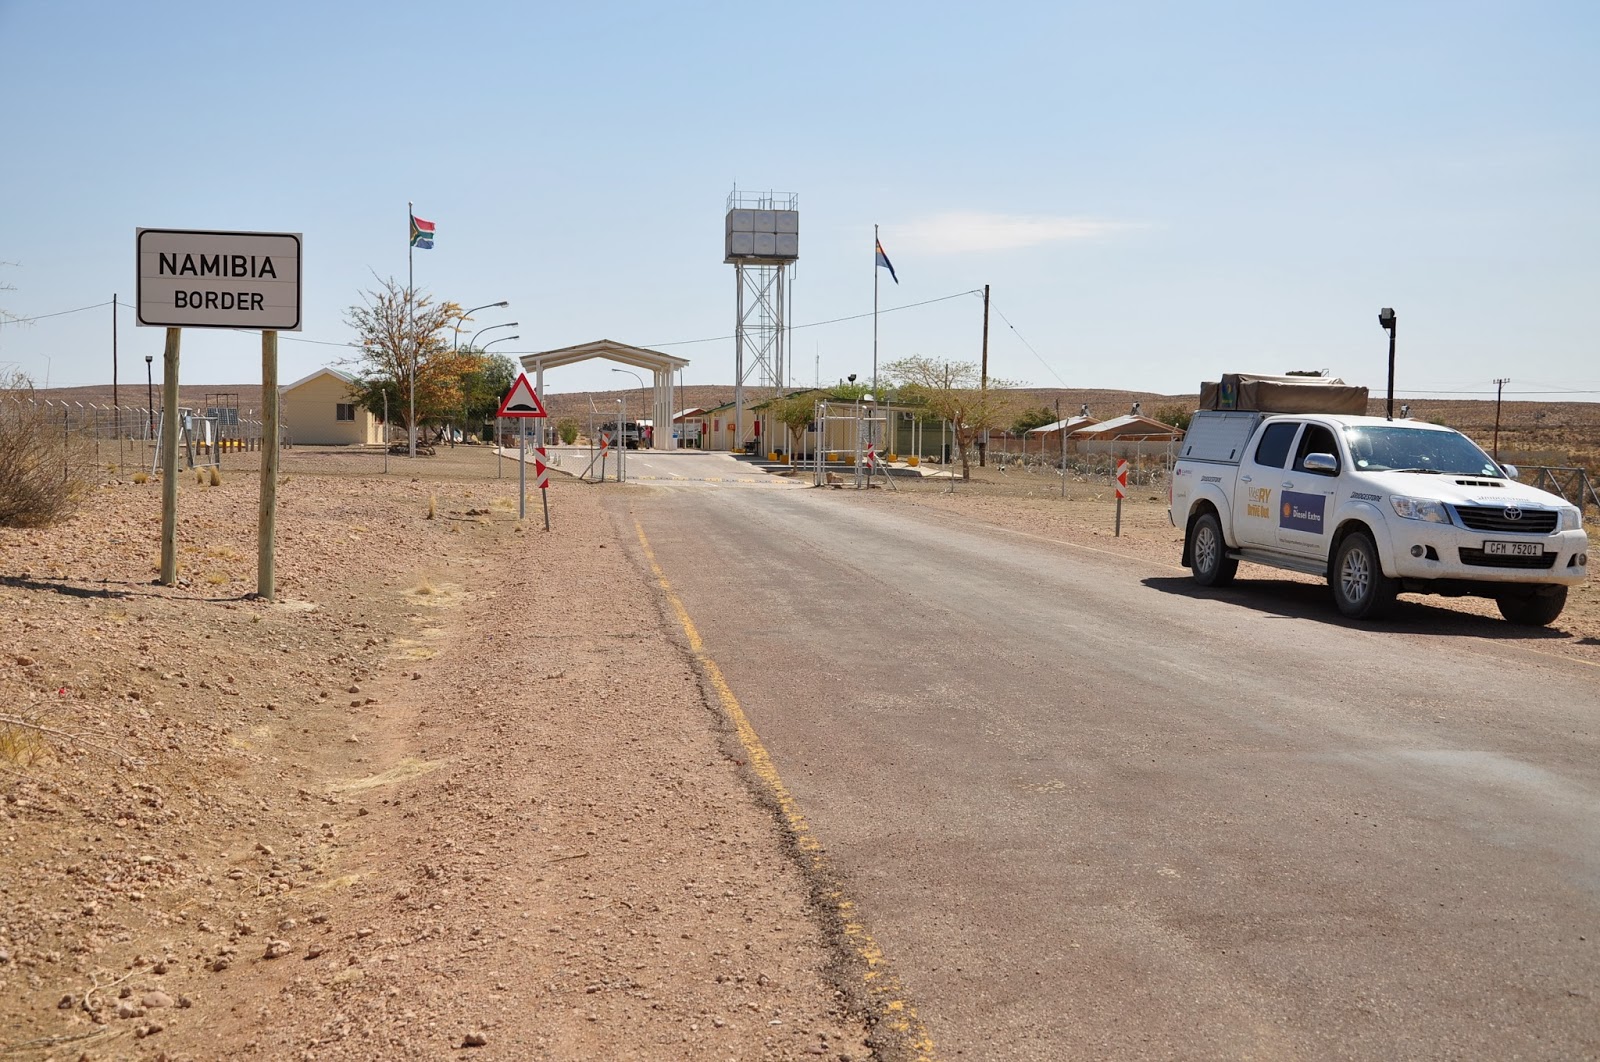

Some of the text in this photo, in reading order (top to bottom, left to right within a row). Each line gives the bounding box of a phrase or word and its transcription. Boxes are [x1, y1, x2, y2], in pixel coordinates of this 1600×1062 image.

[159, 252, 277, 279] NAMIBIA
[174, 290, 264, 311] BORDER
[1350, 490, 1383, 502] BRIDGESTONE
[1292, 509, 1321, 521] Diesel Extra
[1490, 542, 1537, 556] CFM 75201
